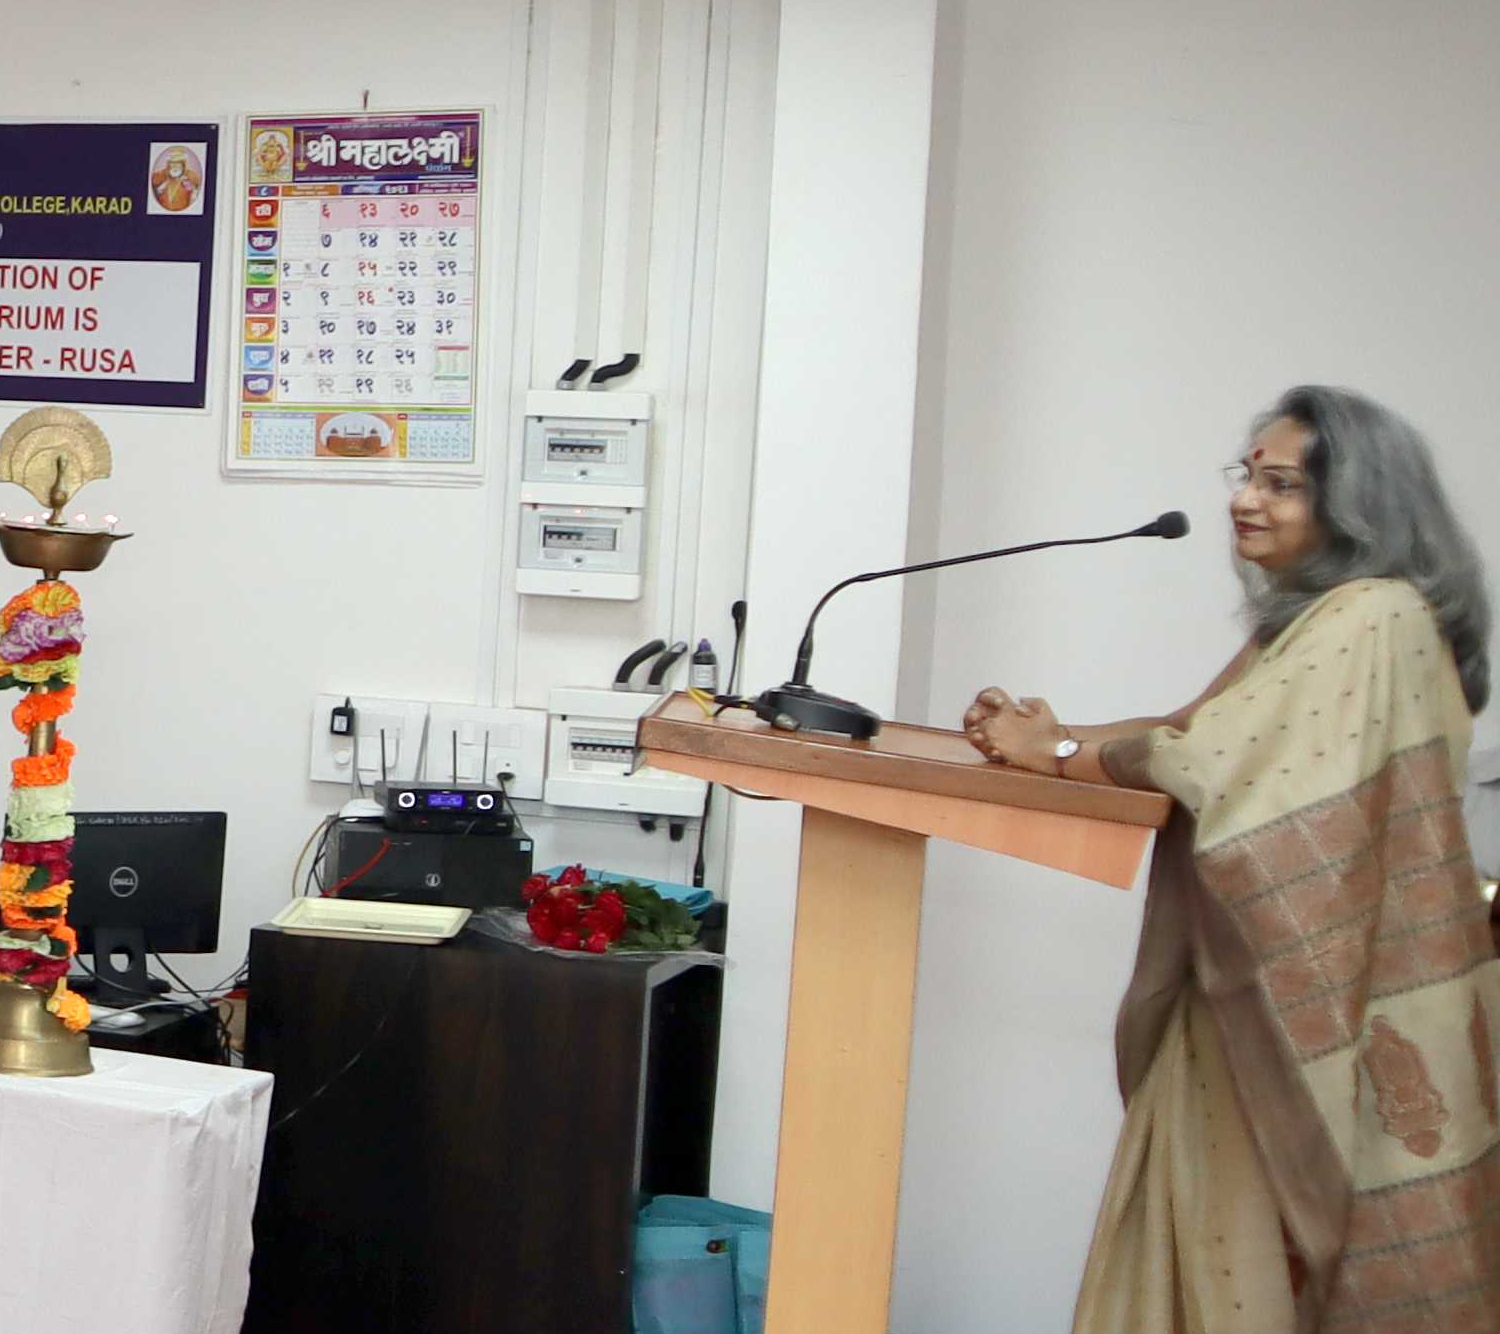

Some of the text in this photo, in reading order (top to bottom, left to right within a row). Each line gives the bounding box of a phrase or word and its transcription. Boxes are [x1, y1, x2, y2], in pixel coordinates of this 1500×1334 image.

[306, 131, 460, 169] श्री महालक्ष्मी
[321, 203, 331, 219] ६
[359, 203, 378, 218] १३
[400, 203, 419, 218] २०
[438, 202, 460, 218] २७
[321, 233, 332, 247] ७
[359, 232, 379, 248] १४
[399, 232, 417, 247] २१
[438, 231, 457, 247] २८
[282, 262, 291, 277] १
[320, 262, 330, 276] ८
[358, 262, 377, 277] १५
[398, 262, 417, 277] २२
[437, 260, 457, 275] २९
[67, 265, 105, 292] OF
[282, 291, 291, 306] २
[320, 291, 330, 305] ९
[357, 290, 375, 306] १६
[397, 290, 415, 306] २३
[436, 289, 456, 304] ३०
[74, 306, 98, 332] IS
[281, 320, 289, 334] ३
[319, 320, 336, 335] १०
[357, 320, 377, 335] १७
[396, 320, 416, 335] २४
[435, 320, 453, 335] ३१
[59, 347, 136, 374] RUSA
[280, 351, 290, 364] ४
[318, 349, 335, 364] ११
[356, 349, 374, 365] १८
[395, 349, 415, 364] २५
[280, 379, 289, 393] ५
[317, 378, 335, 394] १२
[356, 378, 374, 393] १९
[395, 378, 413, 393] २६
